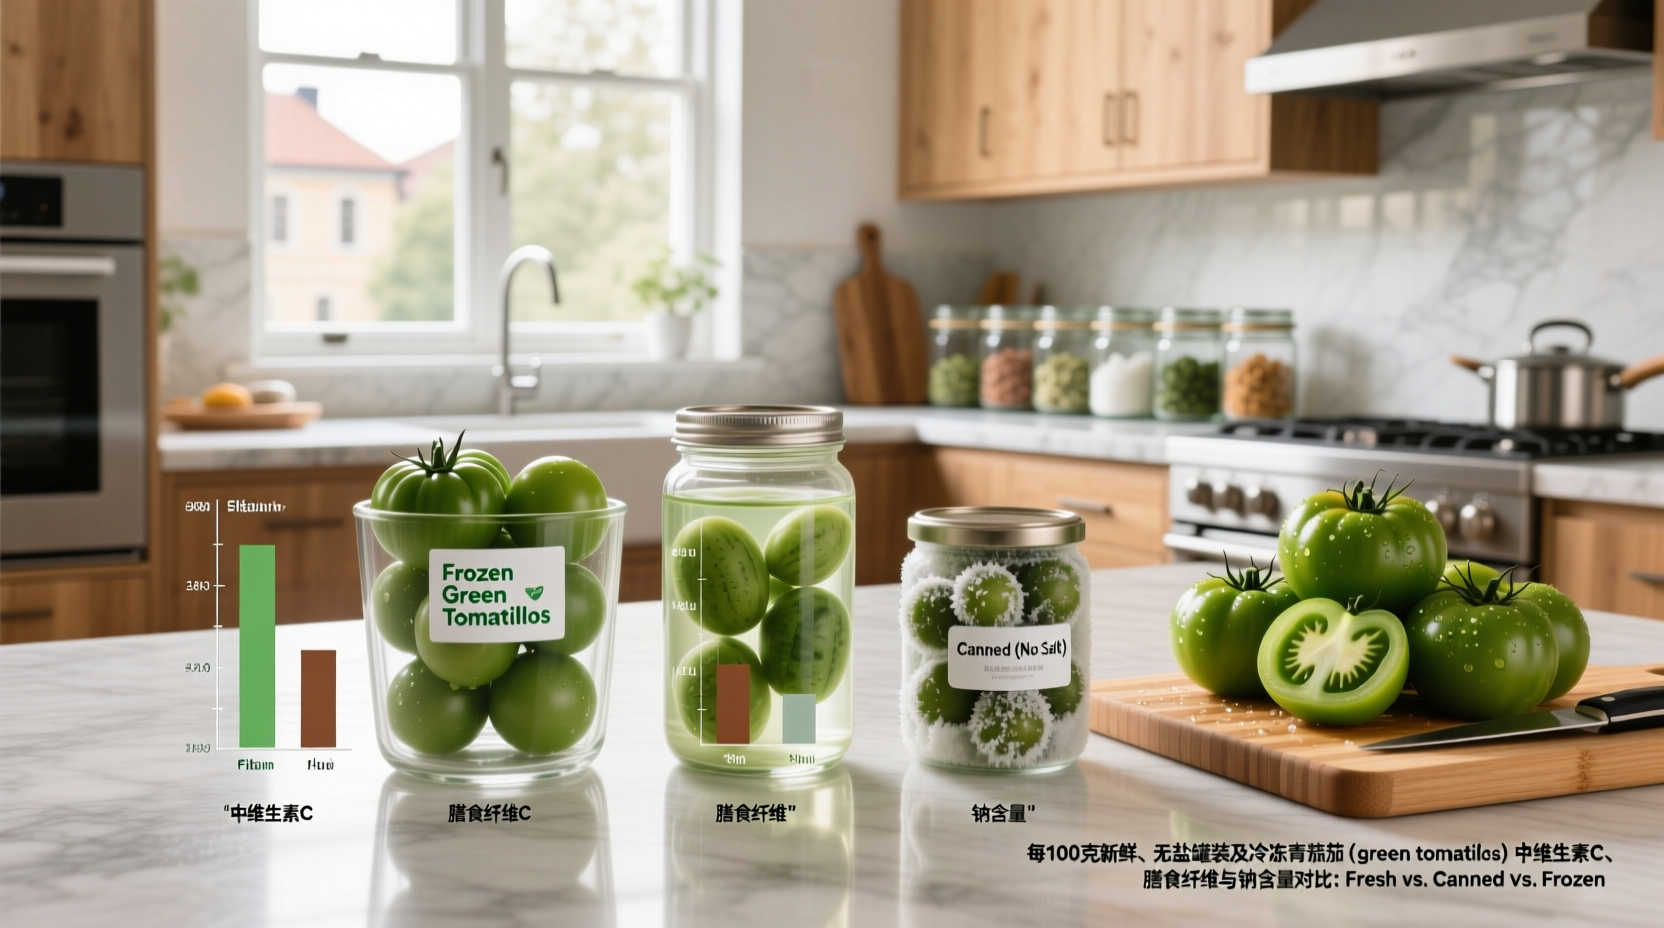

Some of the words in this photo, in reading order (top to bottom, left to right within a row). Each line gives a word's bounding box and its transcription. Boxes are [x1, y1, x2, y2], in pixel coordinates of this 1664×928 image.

[442, 563, 514, 582] Frozen
[442, 585, 507, 604] Green
[442, 606, 551, 627] Tomatillos
[957, 641, 1011, 656] Canned
[1015, 641, 1039, 660] (No
